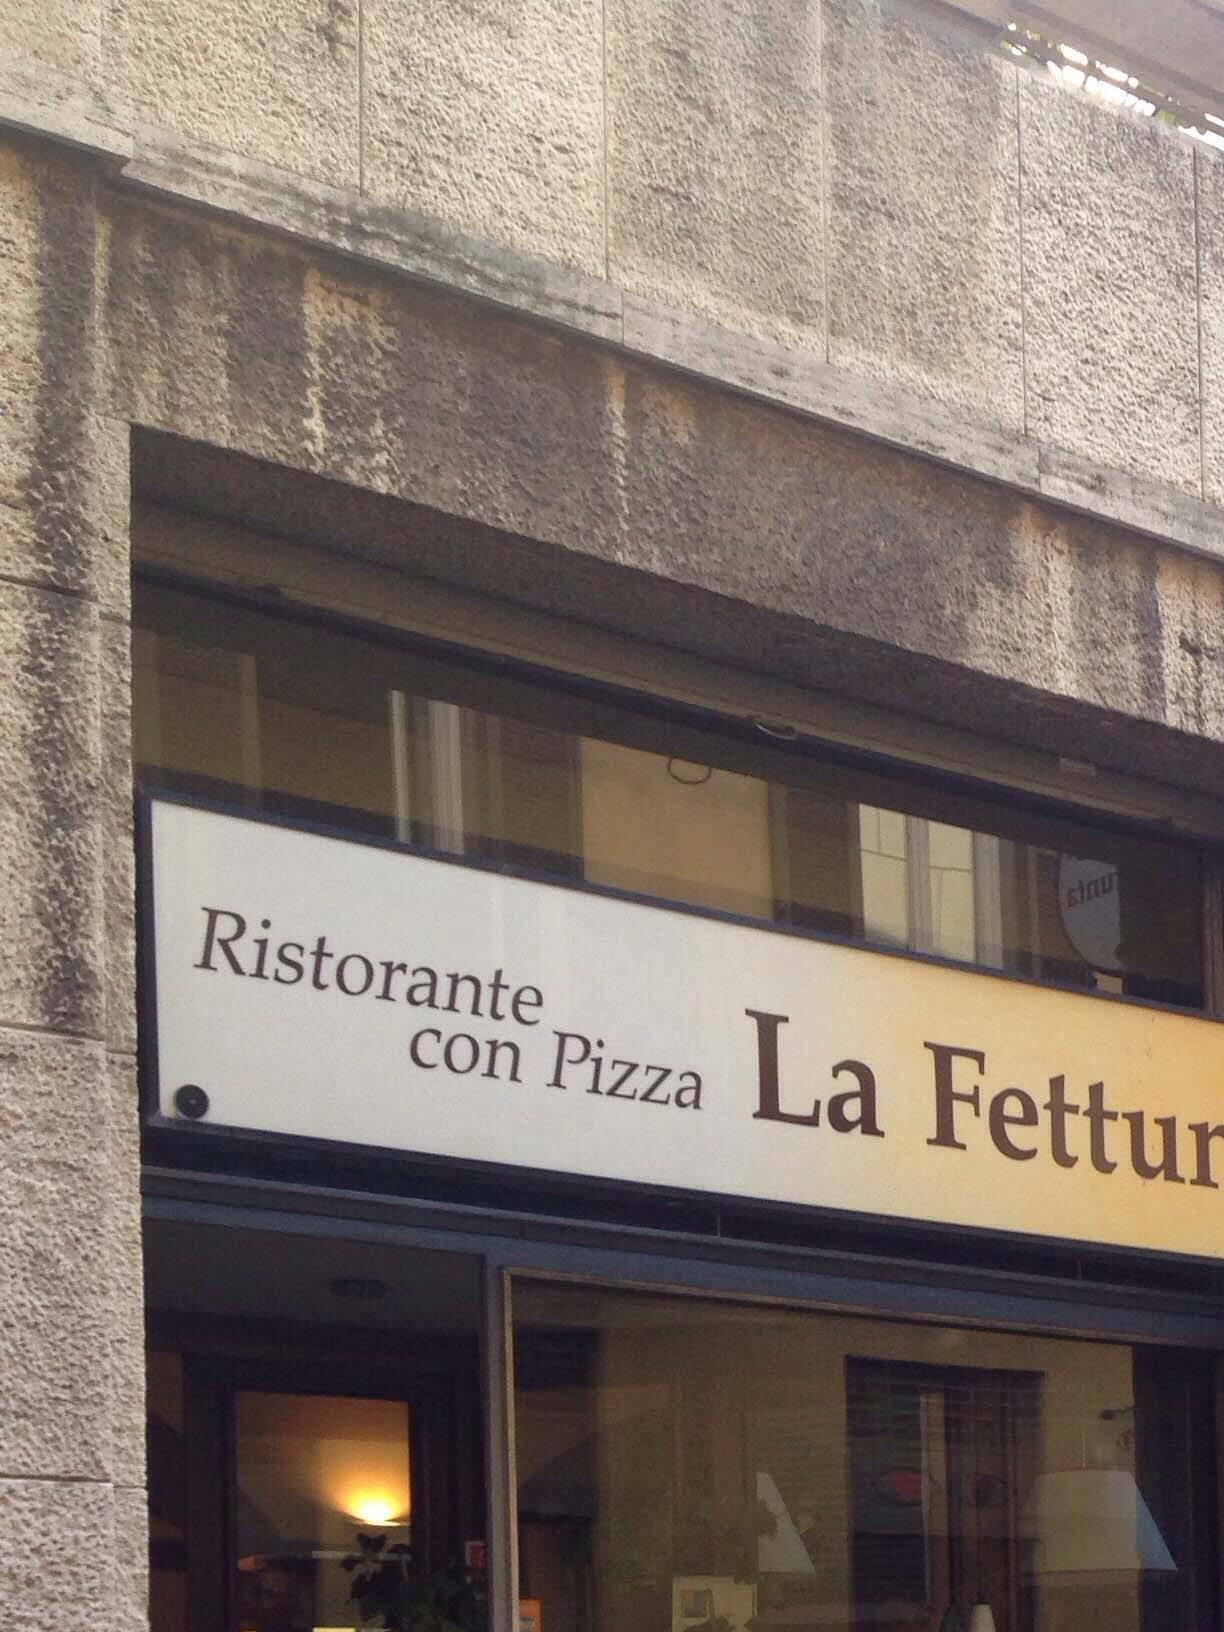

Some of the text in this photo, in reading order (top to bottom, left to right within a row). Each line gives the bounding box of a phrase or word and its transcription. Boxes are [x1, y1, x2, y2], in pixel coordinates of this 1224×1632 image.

[193, 907, 544, 1026] Ristorante
[409, 1026, 703, 1112] con Pizza
[745, 1008, 885, 1138] La
